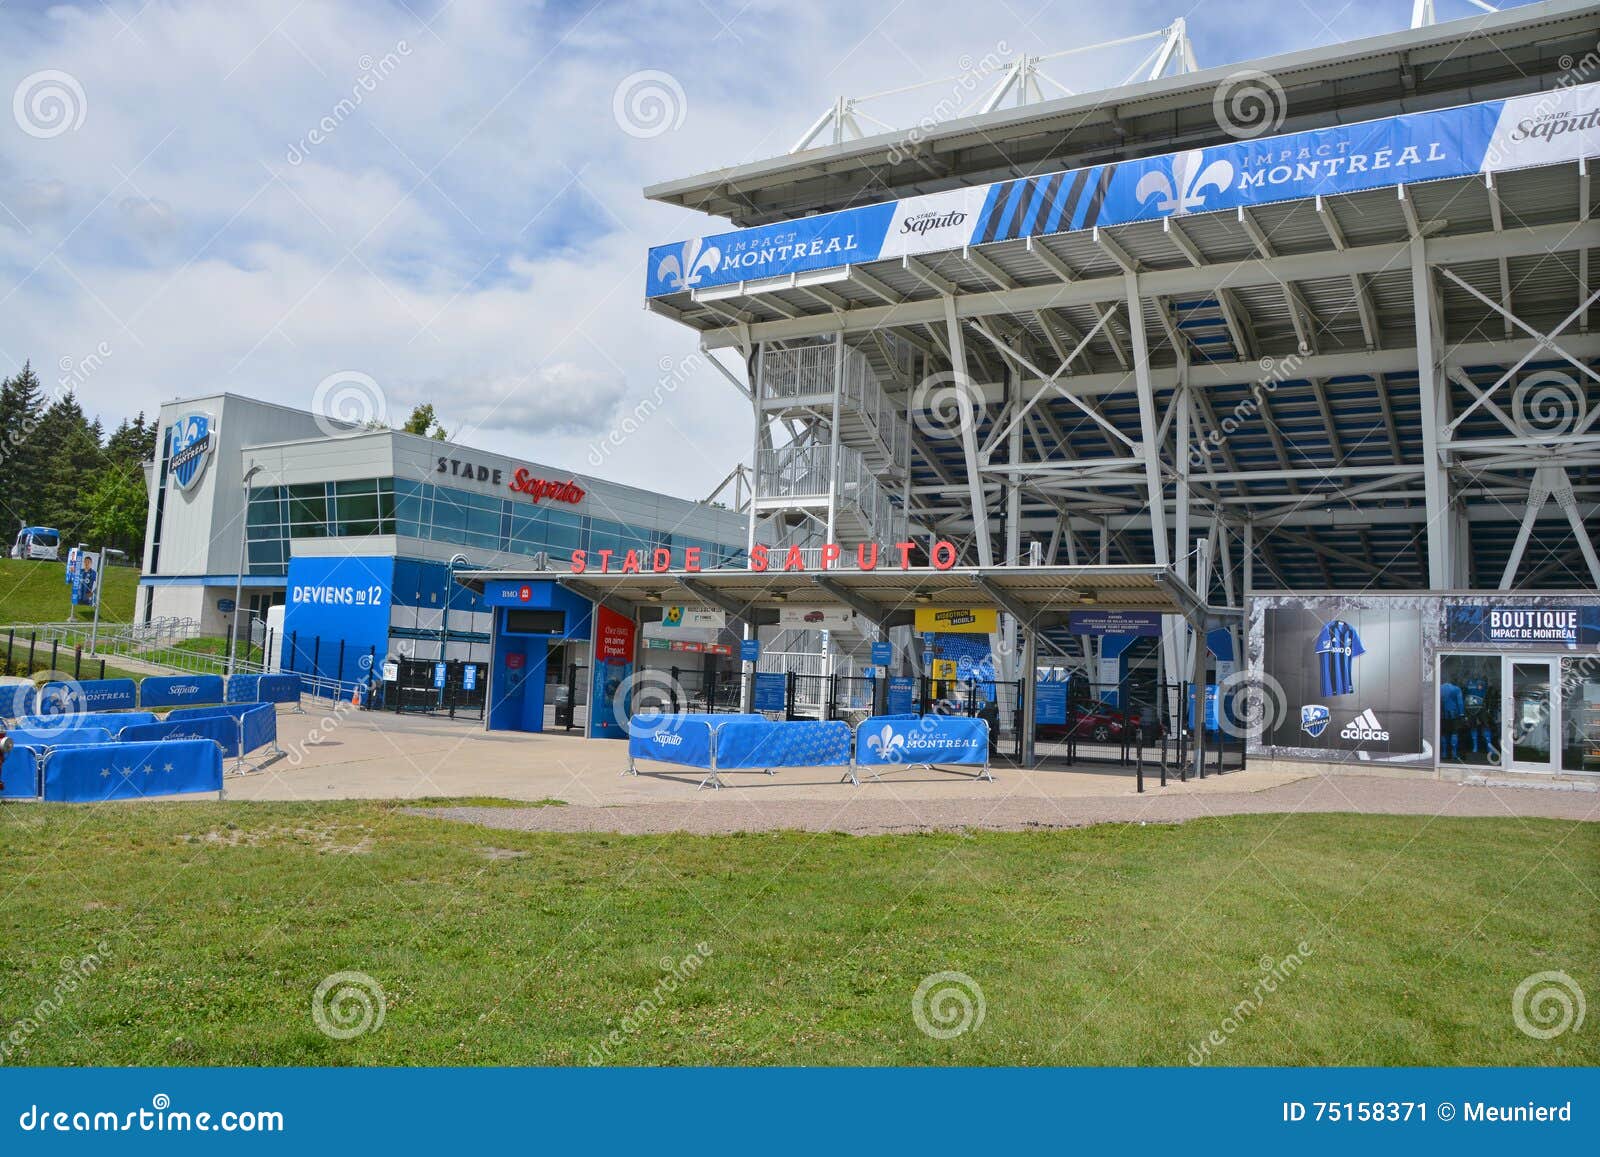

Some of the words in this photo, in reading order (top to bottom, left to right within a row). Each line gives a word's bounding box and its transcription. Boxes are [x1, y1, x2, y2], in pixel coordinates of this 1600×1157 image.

[1512, 108, 1600, 143] Saput
[1242, 141, 1350, 168] IMPACT
[1238, 142, 1446, 190] MONTRÉAL
[900, 210, 968, 236] Saputo
[722, 235, 857, 270] MONTRÉAL
[726, 232, 797, 253] IMPACT
[437, 457, 502, 485] STADE
[508, 466, 586, 504] Saputo
[570, 547, 702, 574] STADE
[750, 541, 957, 572] SAPUTO
[292, 586, 353, 605] DEVIENS
[368, 586, 382, 605] 12
[502, 590, 518, 598] BMO
[1490, 611, 1577, 628] BOUTIQUE
[1490, 629, 1520, 638] IMPACT
[1521, 629, 1532, 638] DE
[1533, 628, 1576, 638] MONTRÉAL
[168, 685, 200, 696] Saputo
[653, 730, 682, 747] Saputo
[907, 738, 978, 748] MONTRÉAL
[1341, 729, 1389, 741] adidas
